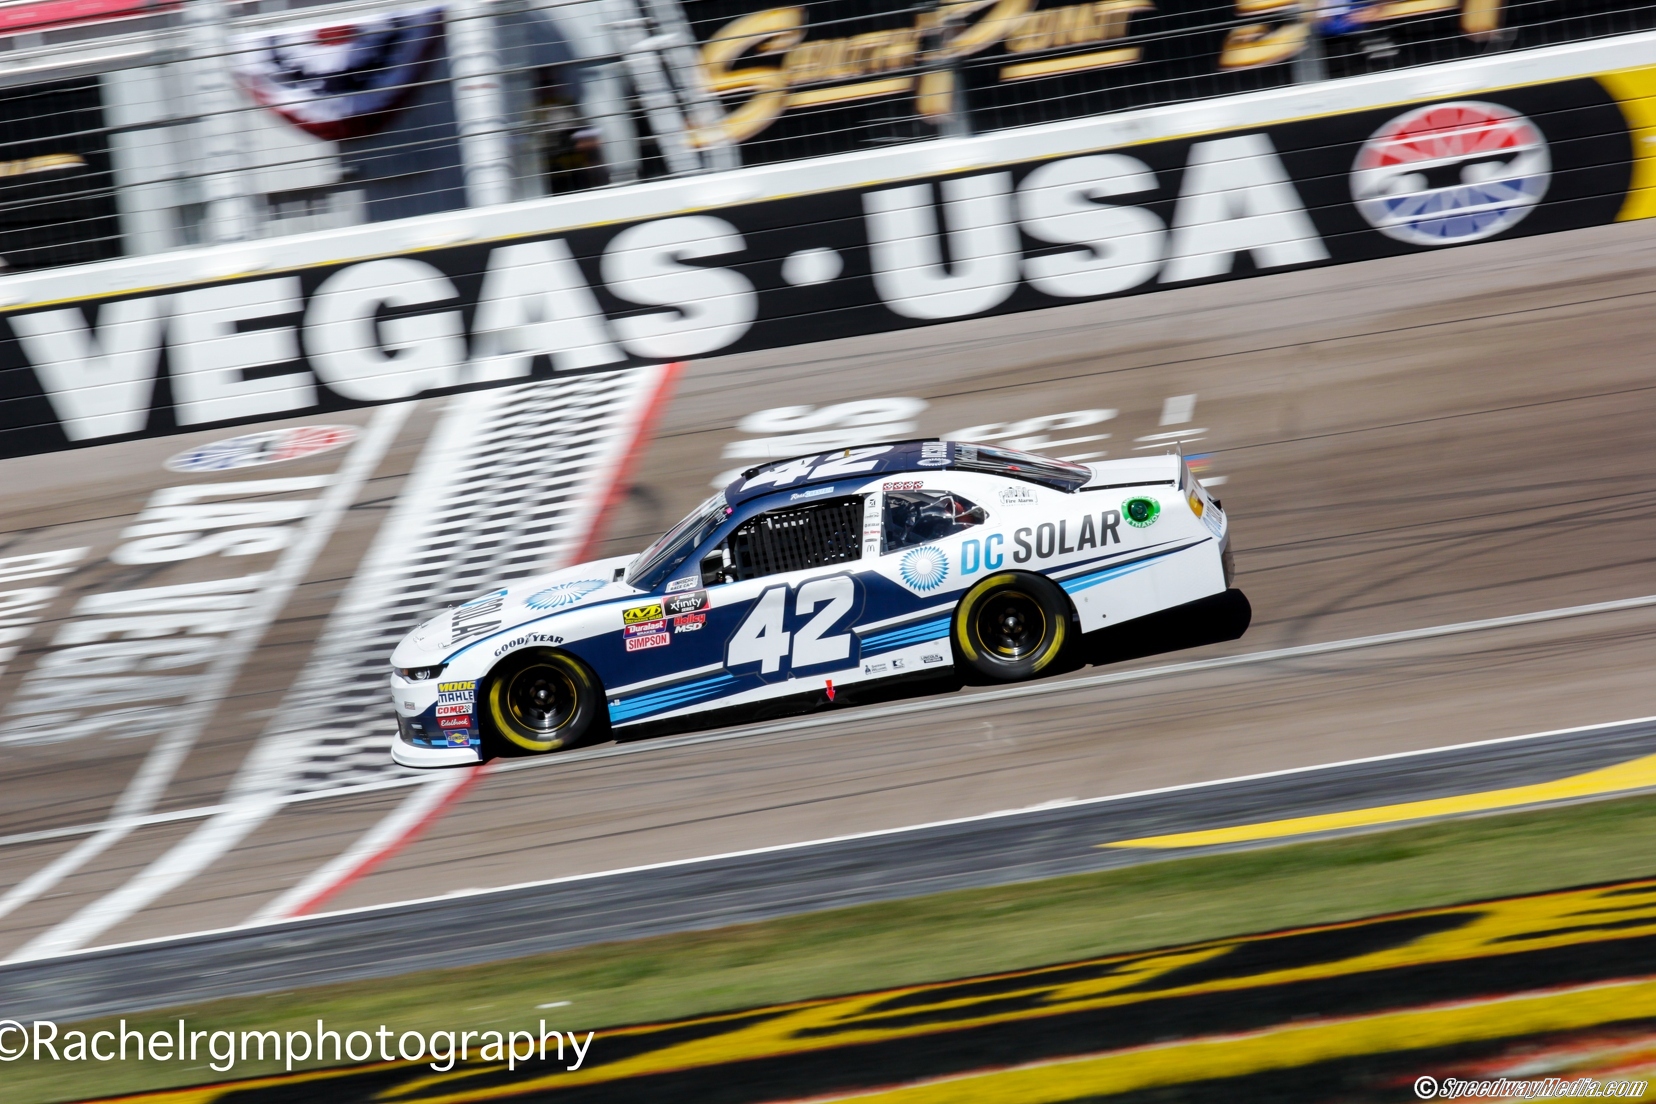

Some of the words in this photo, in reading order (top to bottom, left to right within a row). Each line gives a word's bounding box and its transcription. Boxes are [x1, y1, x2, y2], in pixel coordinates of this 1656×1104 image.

[8, 215, 758, 441] VEGAS
[862, 132, 1330, 320] USA
[740, 445, 895, 492] 42
[960, 533, 1004, 576] DC
[1013, 509, 1121, 563] SOLAR
[674, 613, 706, 626] Holley
[727, 575, 855, 674] 42
[627, 621, 664, 633] Duralast
[674, 623, 703, 634] MSD
[628, 634, 667, 650] SIMPSON
[438, 681, 476, 692] MOOG
[438, 691, 474, 703] MAHLE
[437, 705, 465, 715] COMP
[441, 718, 469, 727] Edelbrock
